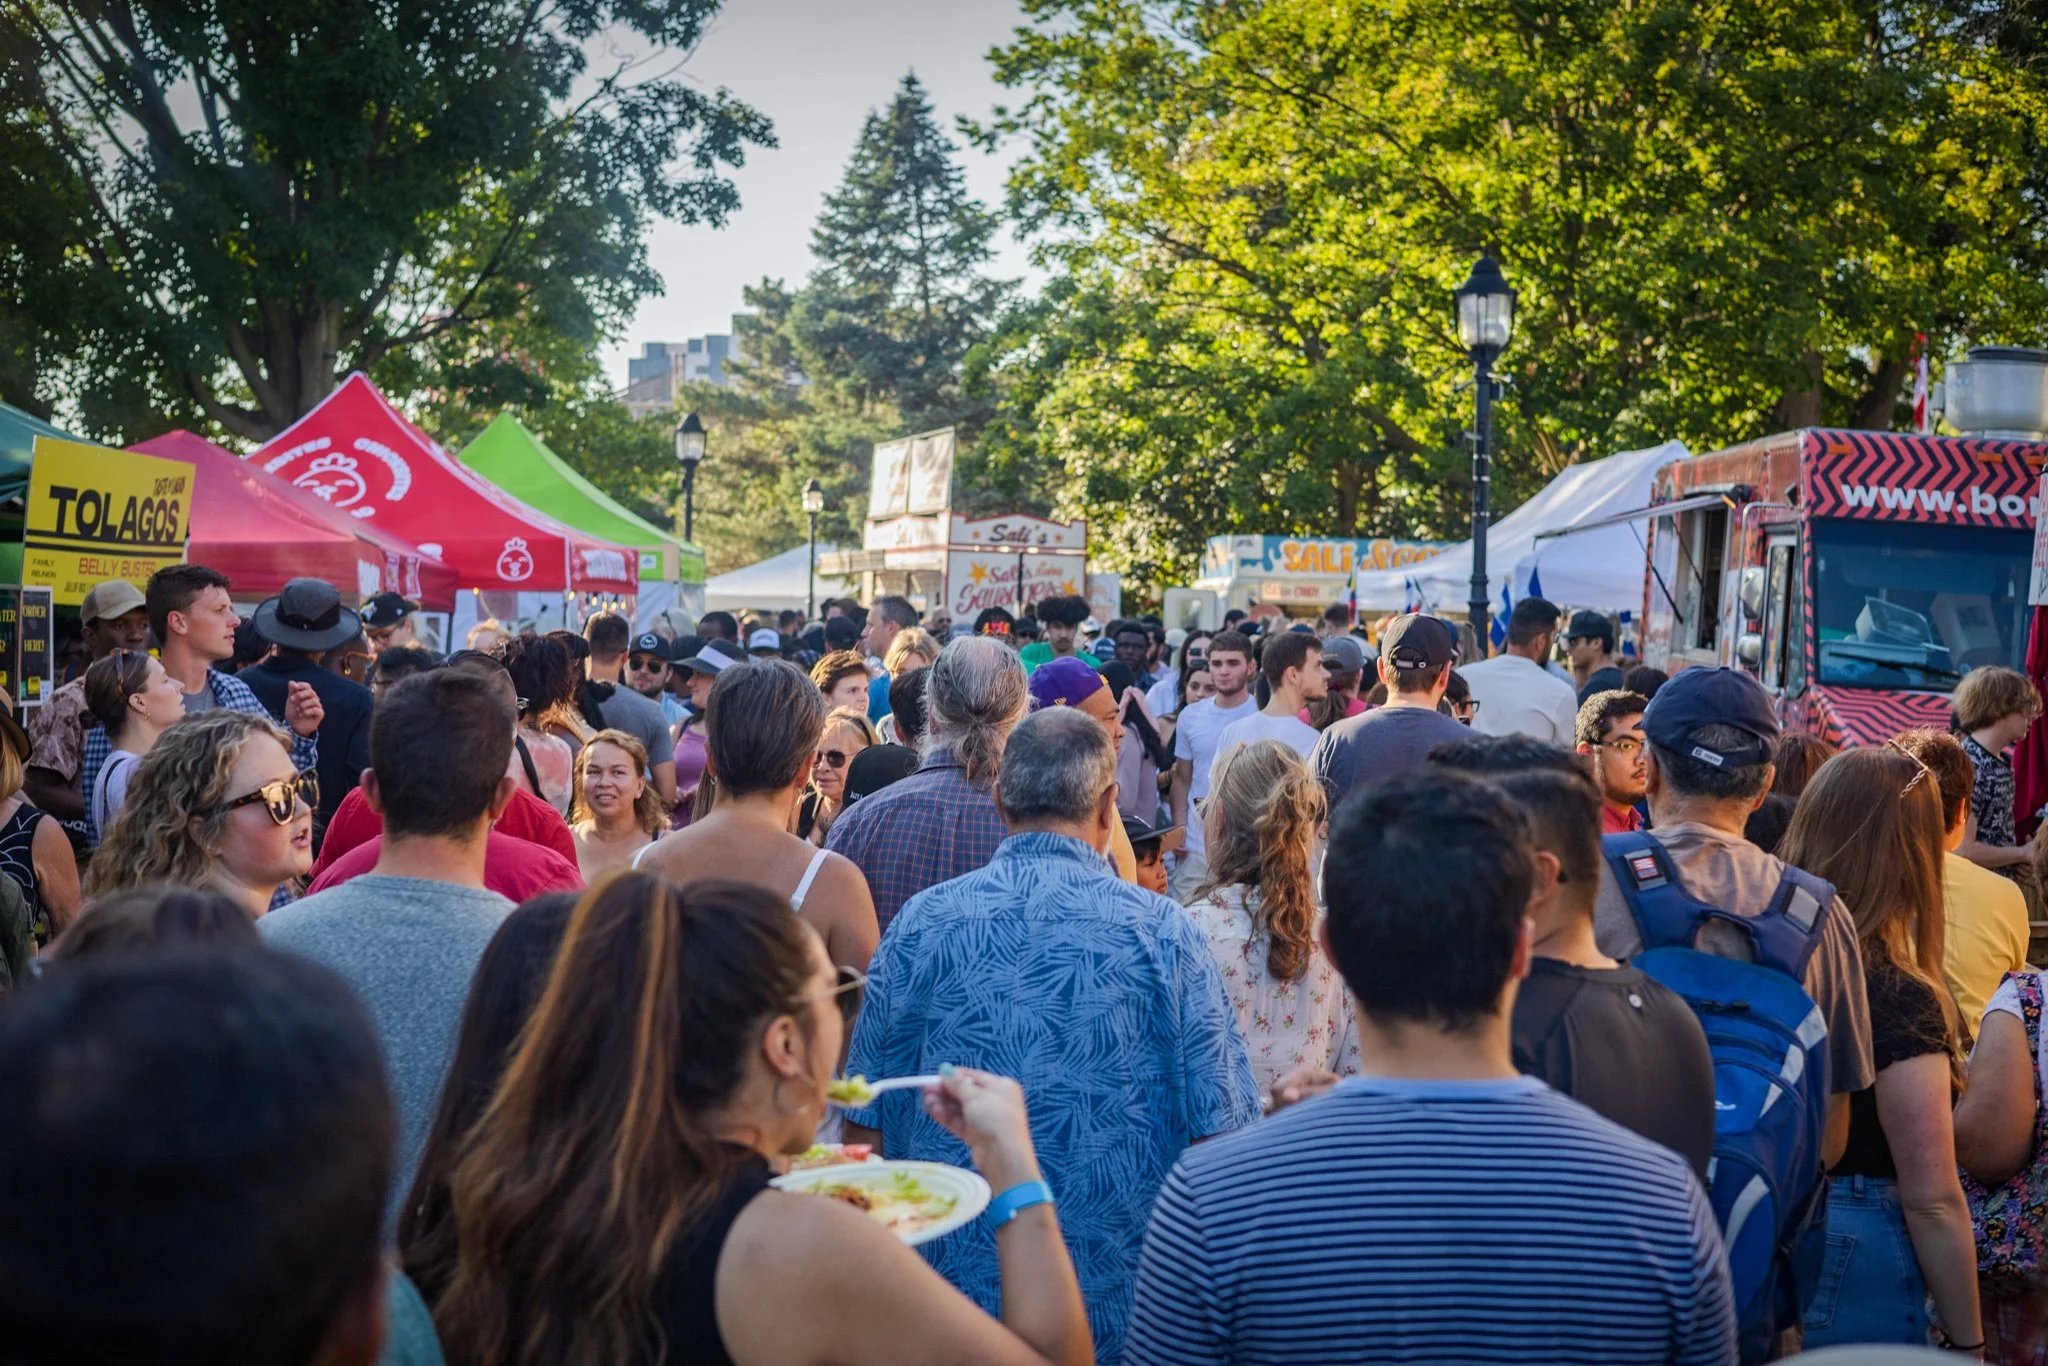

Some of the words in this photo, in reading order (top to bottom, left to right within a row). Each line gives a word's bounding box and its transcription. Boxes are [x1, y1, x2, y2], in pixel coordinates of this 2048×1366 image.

[49, 485, 180, 544] TOLAGOS
[78, 557, 119, 577] BELLY
[22, 604, 47, 618] ORDER
